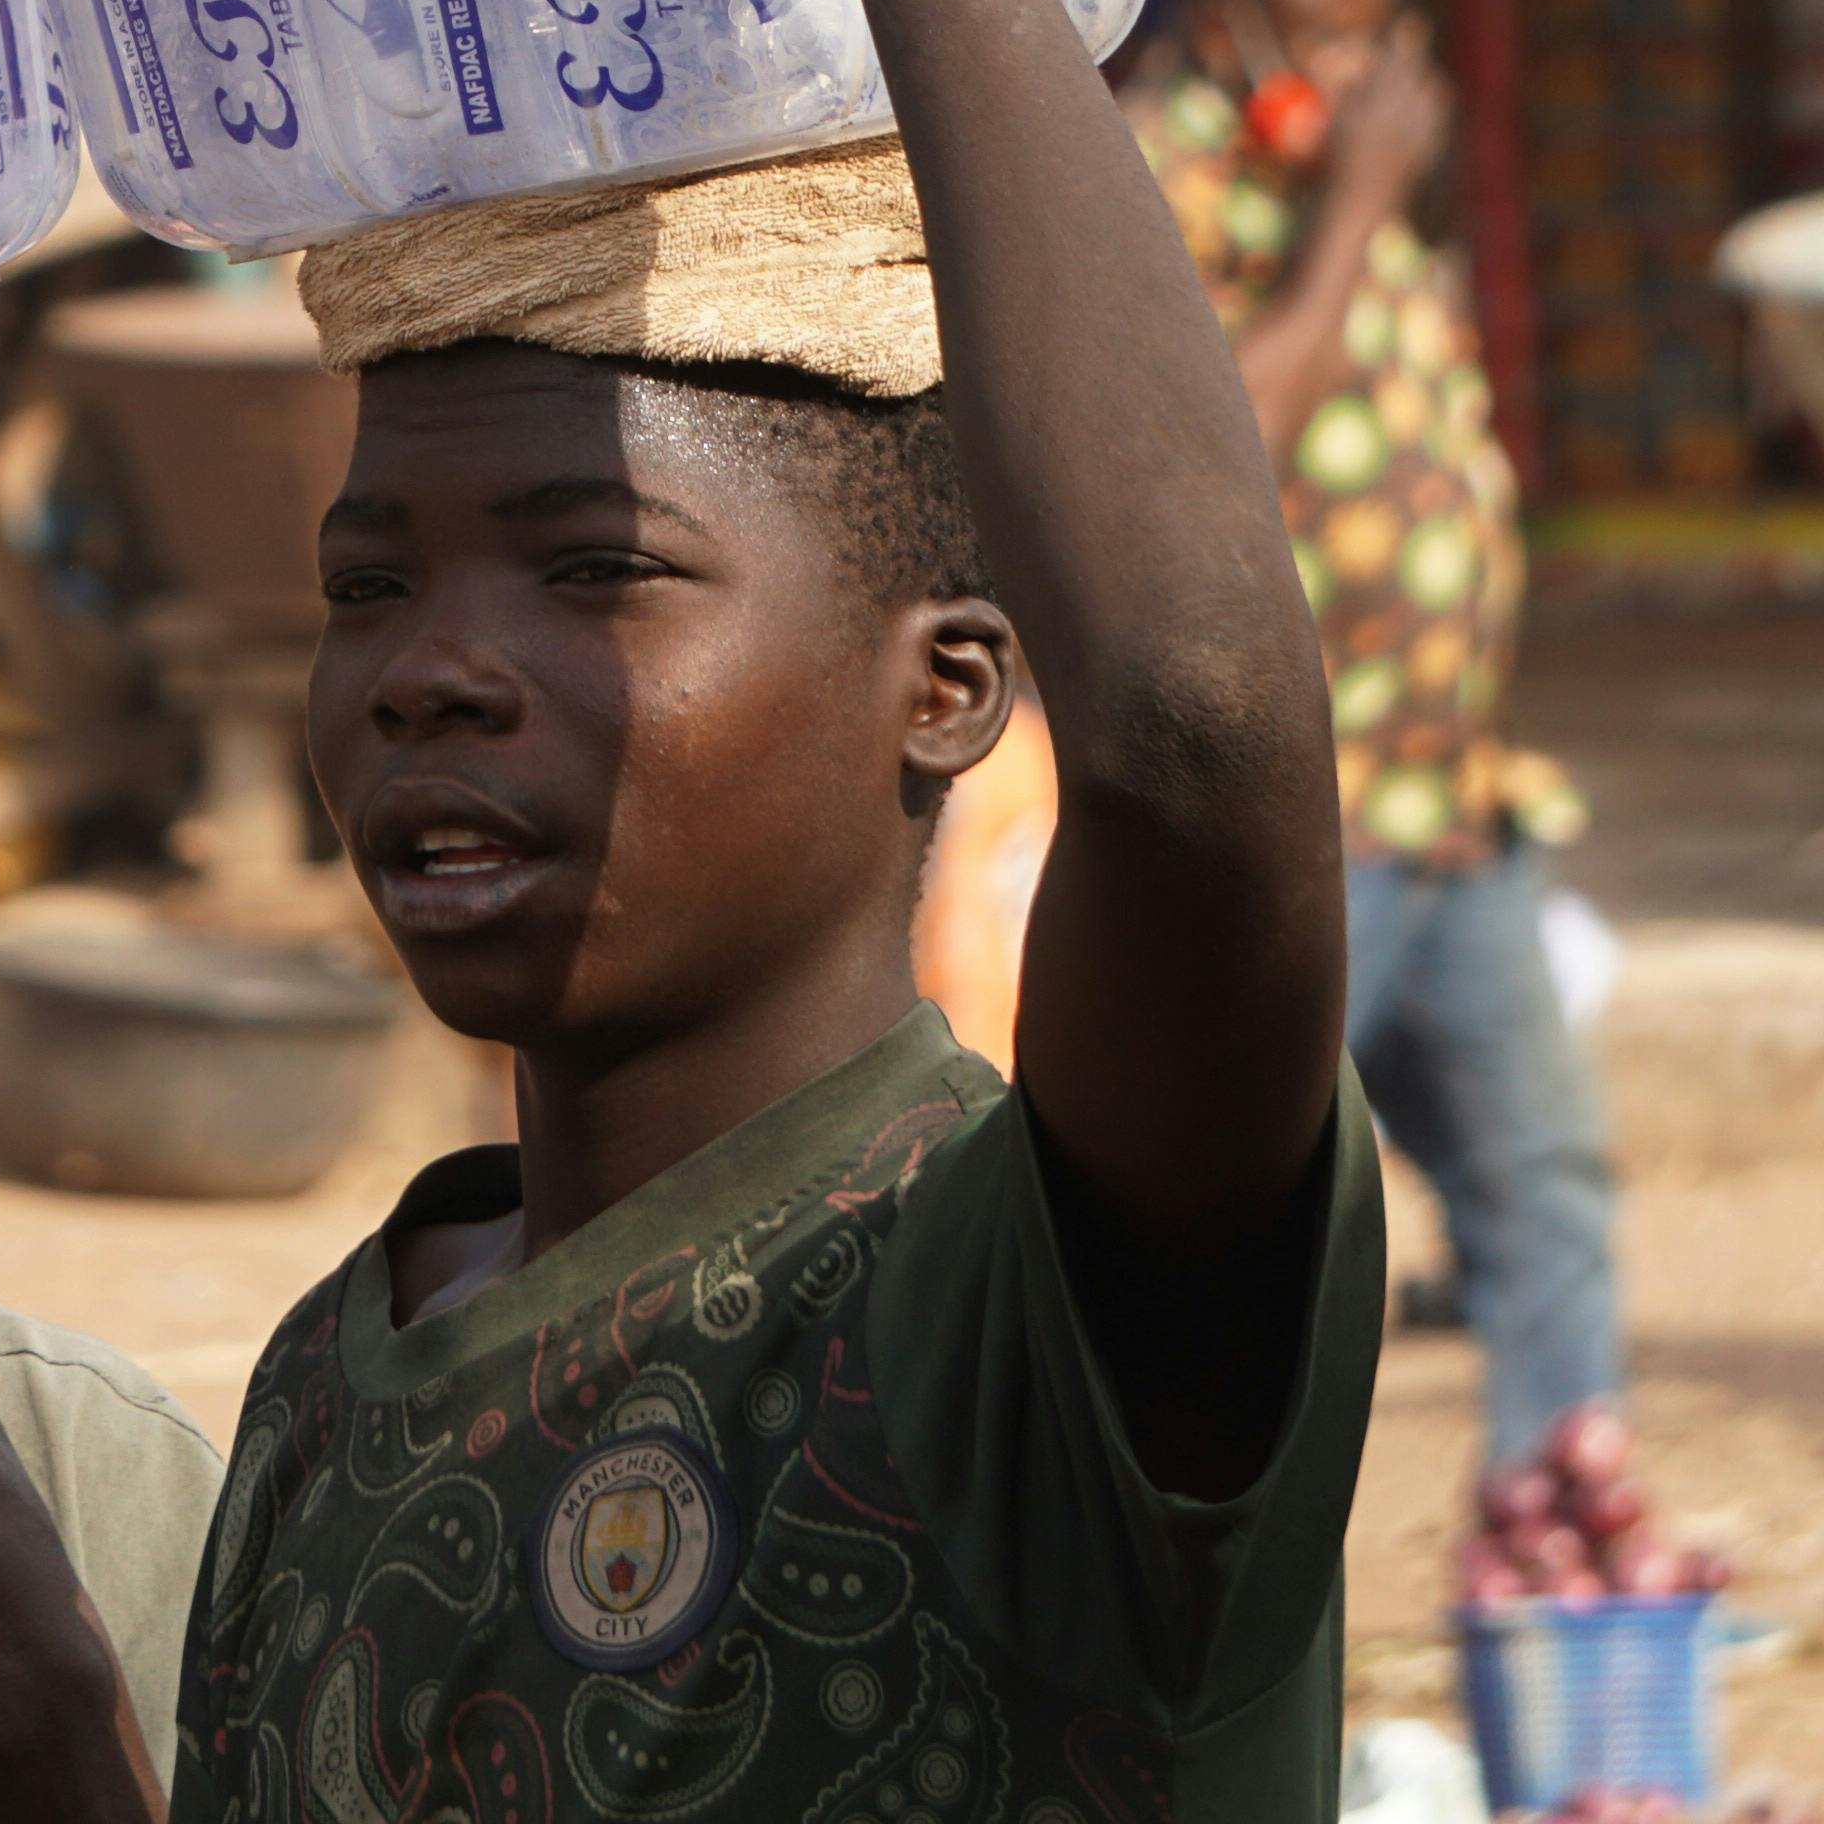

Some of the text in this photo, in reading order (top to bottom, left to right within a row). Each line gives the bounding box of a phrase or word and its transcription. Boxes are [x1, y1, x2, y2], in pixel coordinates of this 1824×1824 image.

[132, 14, 158, 63] REG
[423, 3, 442, 25] IN
[122, 39, 141, 60] IN
[426, 28, 451, 93] STORE
[129, 77, 156, 128] STORE
[456, 34, 493, 125] NAFDAC
[148, 65, 185, 159] NAFDAC
[562, 1452, 695, 1521] MANCHESTER
[595, 1616, 648, 1637] CITY
